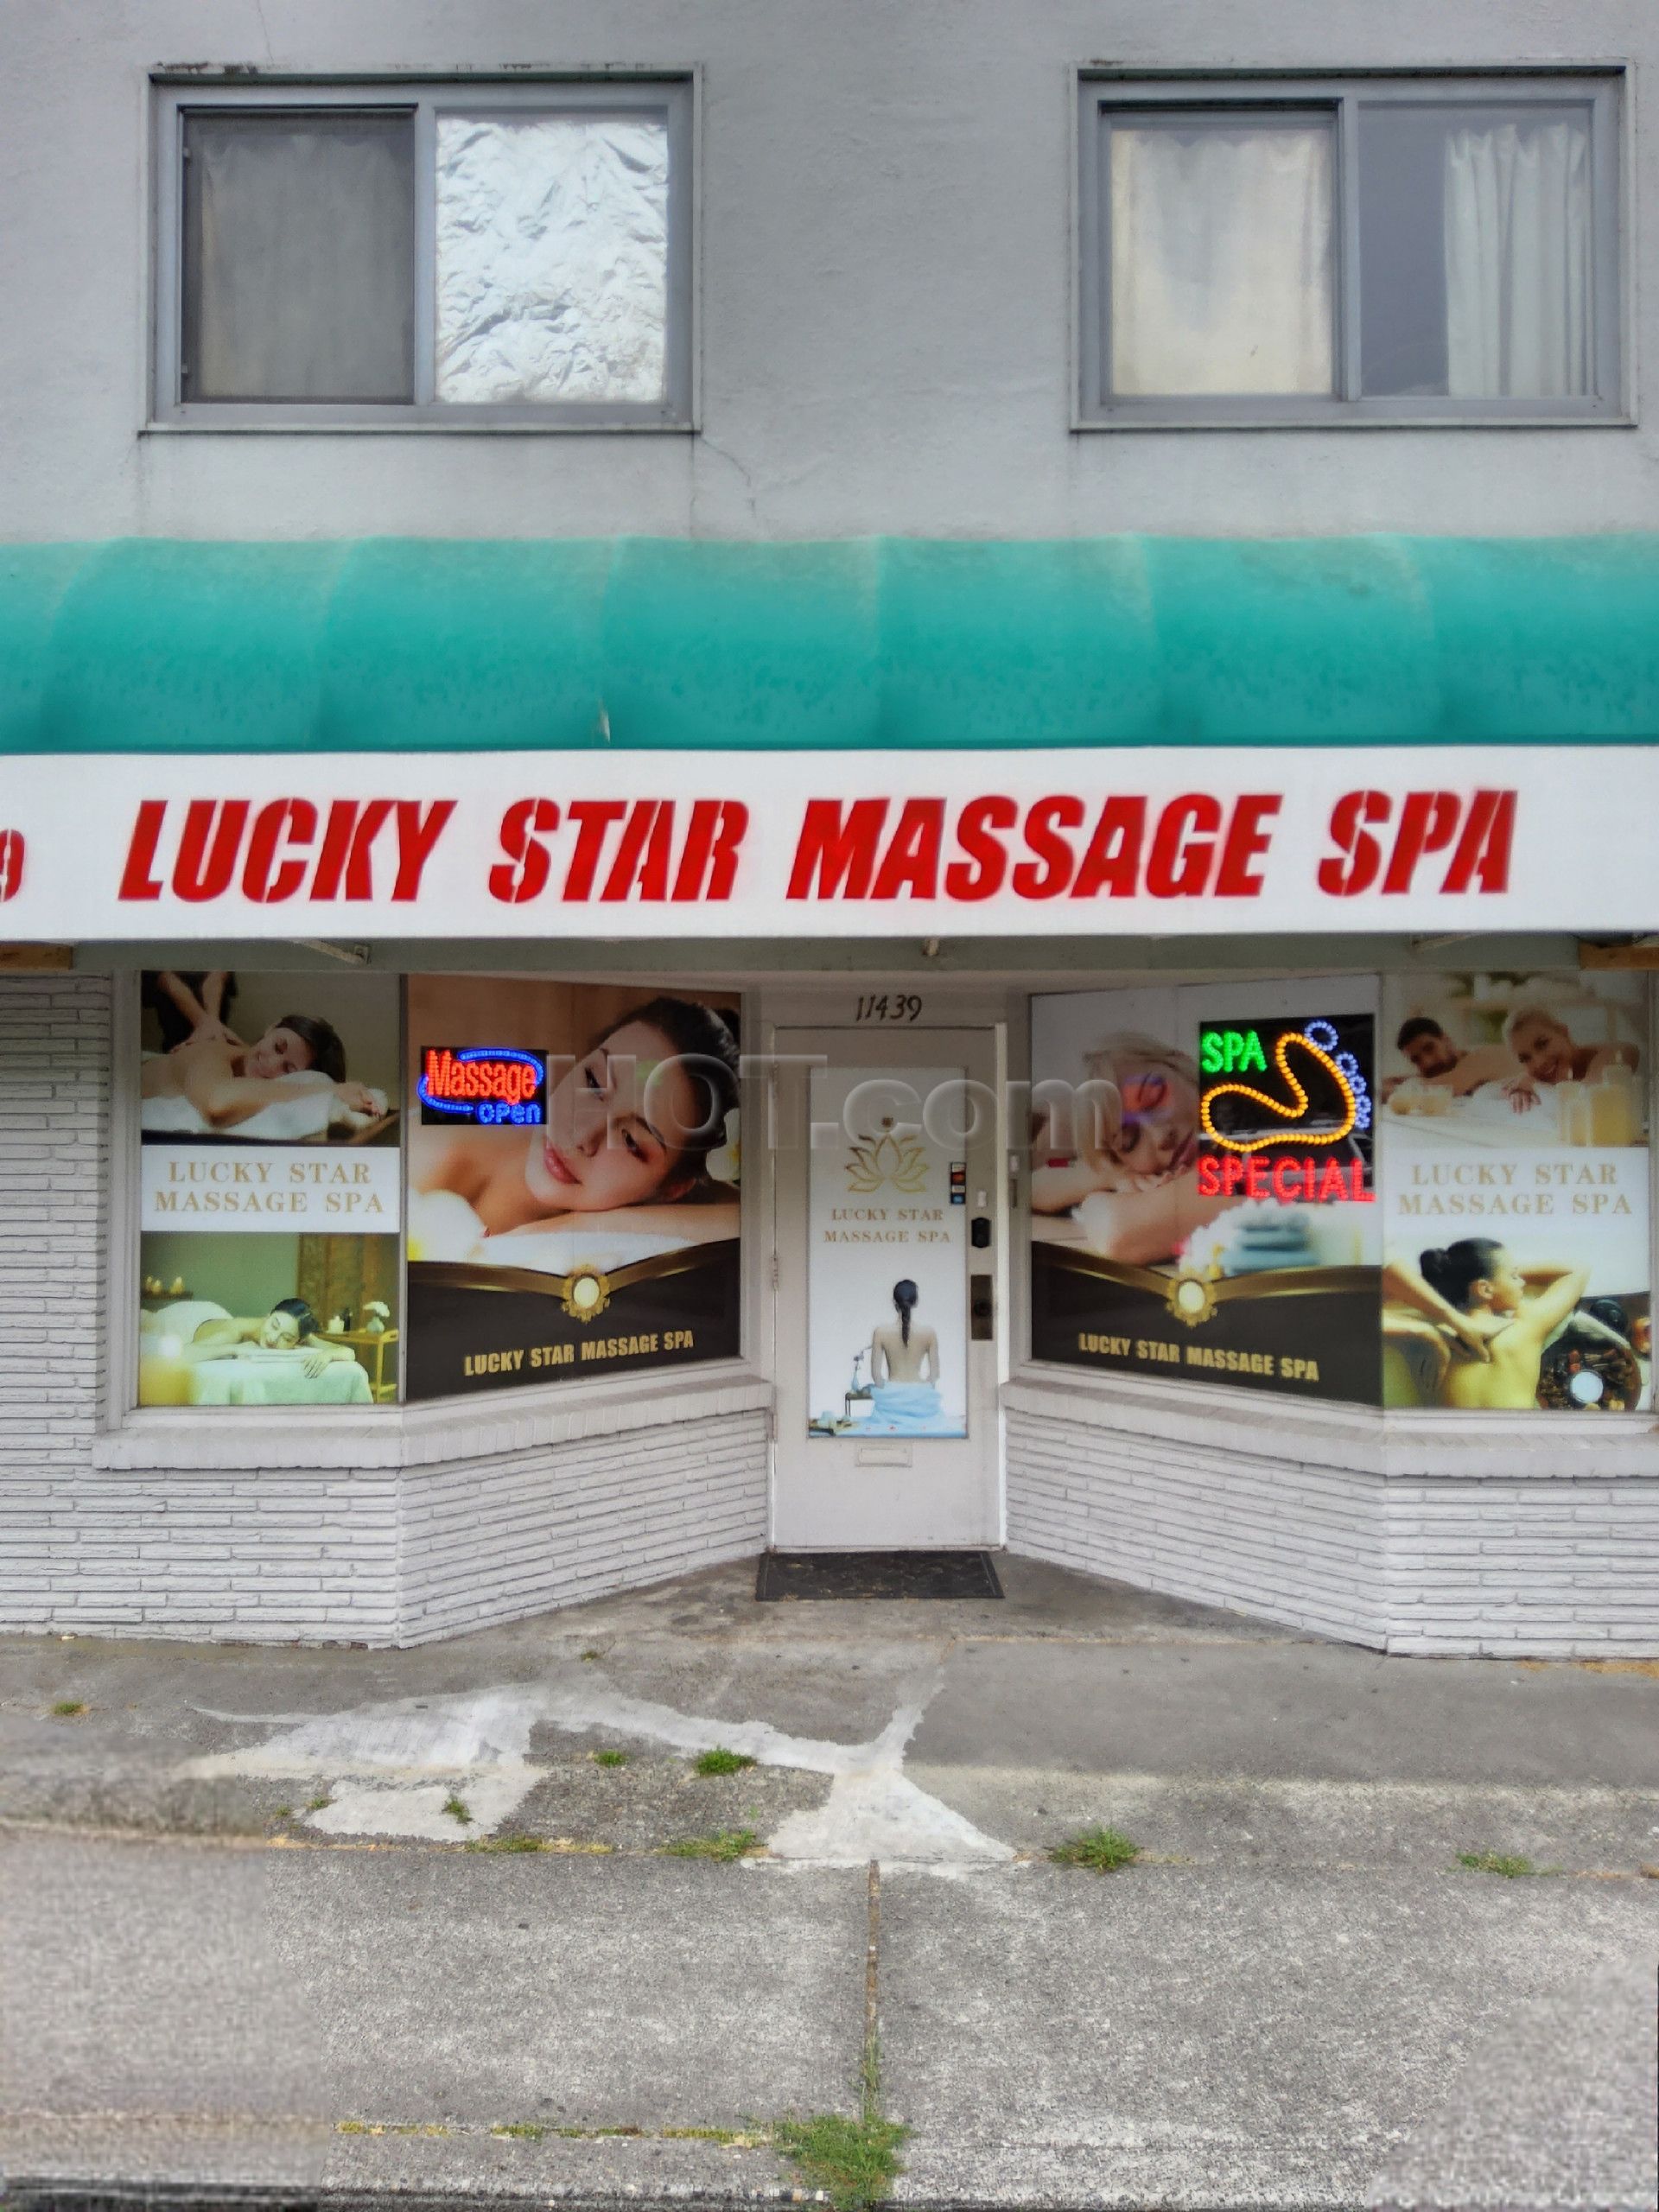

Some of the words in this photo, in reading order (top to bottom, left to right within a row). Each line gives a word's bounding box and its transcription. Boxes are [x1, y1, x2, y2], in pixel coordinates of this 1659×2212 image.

[118, 798, 457, 904] LUCKY
[489, 798, 748, 904] STAR
[786, 793, 1283, 901] MASSAGE
[1319, 789, 1518, 896] SPA
[855, 994, 922, 1021] 11439
[1200, 1030, 1268, 1074] SPA
[426, 1049, 537, 1105] Massage
[168, 1161, 273, 1184] LUCKY
[289, 1163, 371, 1185] STAR
[1198, 1155, 1377, 1205] SPECIAL
[1411, 1164, 1518, 1185] LUCKY
[1535, 1164, 1618, 1185] STAR
[155, 1192, 308, 1213] MASSAGE
[326, 1192, 384, 1214] SPA
[831, 1209, 887, 1221] LUCKY
[897, 1209, 944, 1222] STAR
[1397, 1193, 1554, 1216] MASSAGE
[1572, 1193, 1632, 1216] SPA
[823, 1230, 909, 1243] MASSAGE
[918, 1230, 950, 1243] SPA
[464, 1350, 524, 1376] LUCKY
[530, 1344, 575, 1368] STAR
[581, 1337, 658, 1361] MASSAGE
[664, 1330, 695, 1351] SPA
[1079, 1333, 1130, 1357] LUCKY
[1138, 1340, 1180, 1363] STAR
[1186, 1346, 1275, 1375] MASSAGE
[1280, 1357, 1320, 1382] SPA
